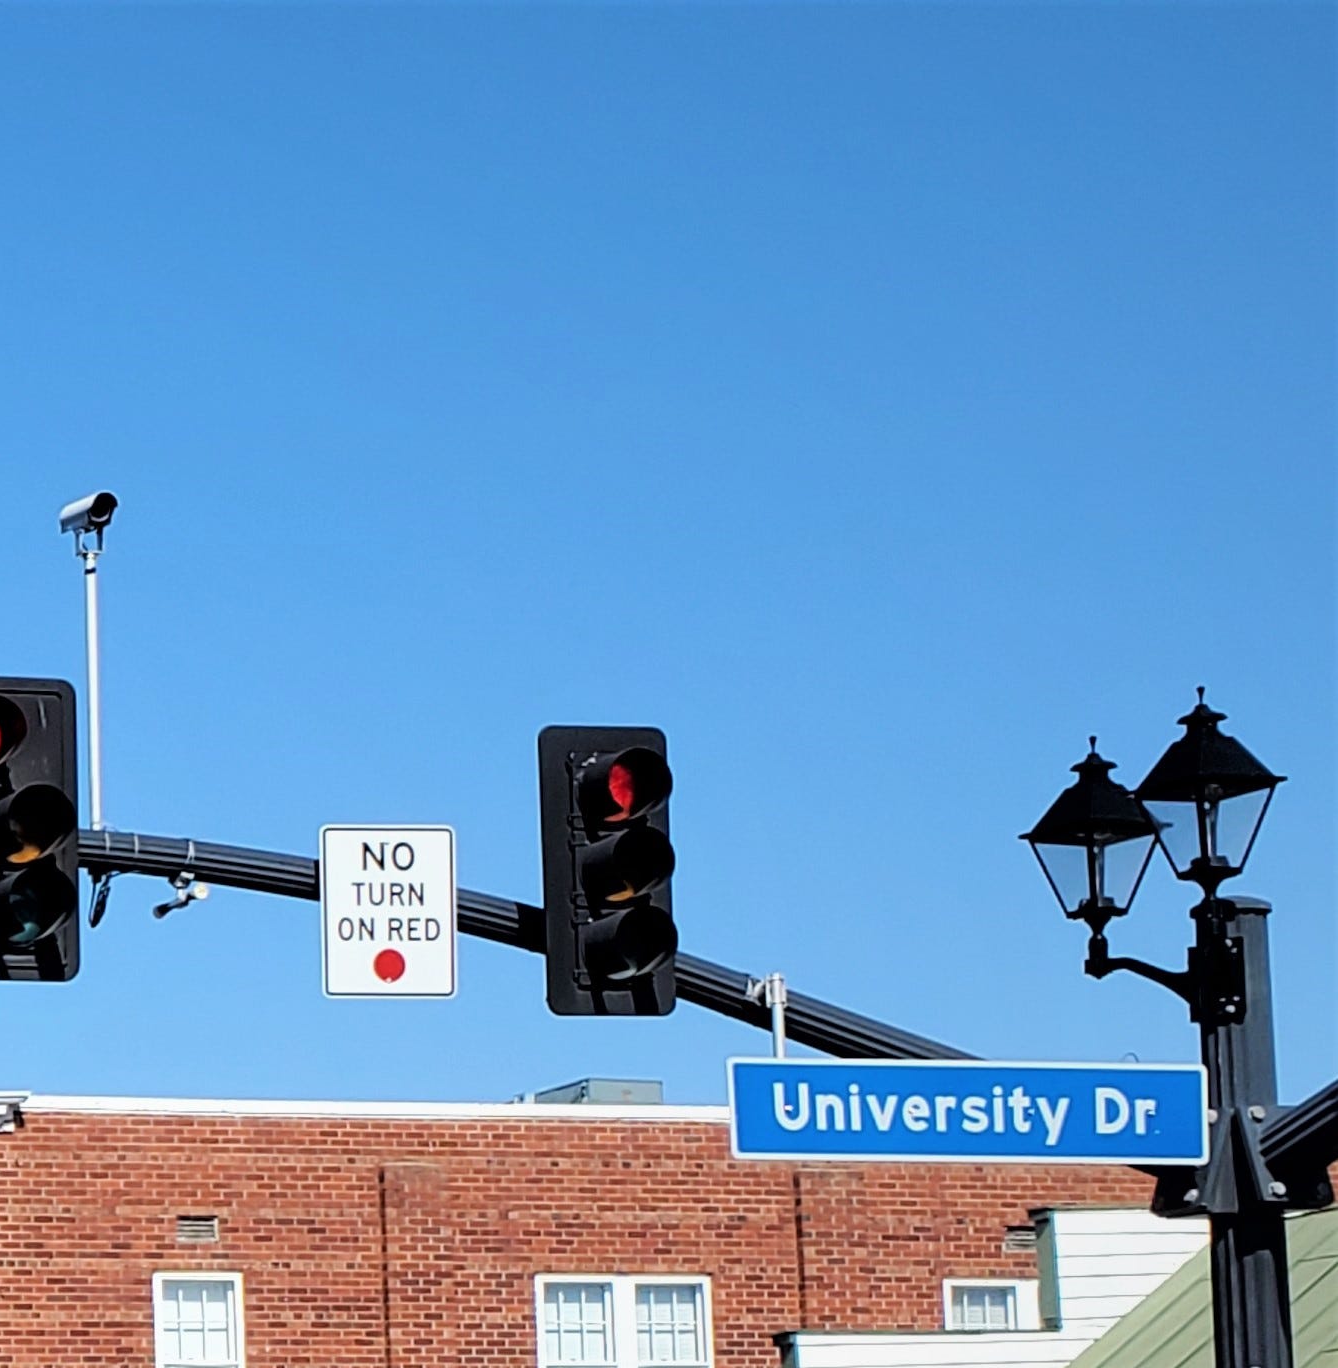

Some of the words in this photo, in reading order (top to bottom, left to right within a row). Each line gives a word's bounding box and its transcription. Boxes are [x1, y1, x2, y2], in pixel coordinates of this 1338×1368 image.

[361, 842, 415, 871] NO
[352, 882, 424, 906] TURN
[338, 917, 375, 941] ON
[388, 918, 441, 942] RED
[773, 1082, 1069, 1145] University
[1095, 1087, 1156, 1135] Dr
